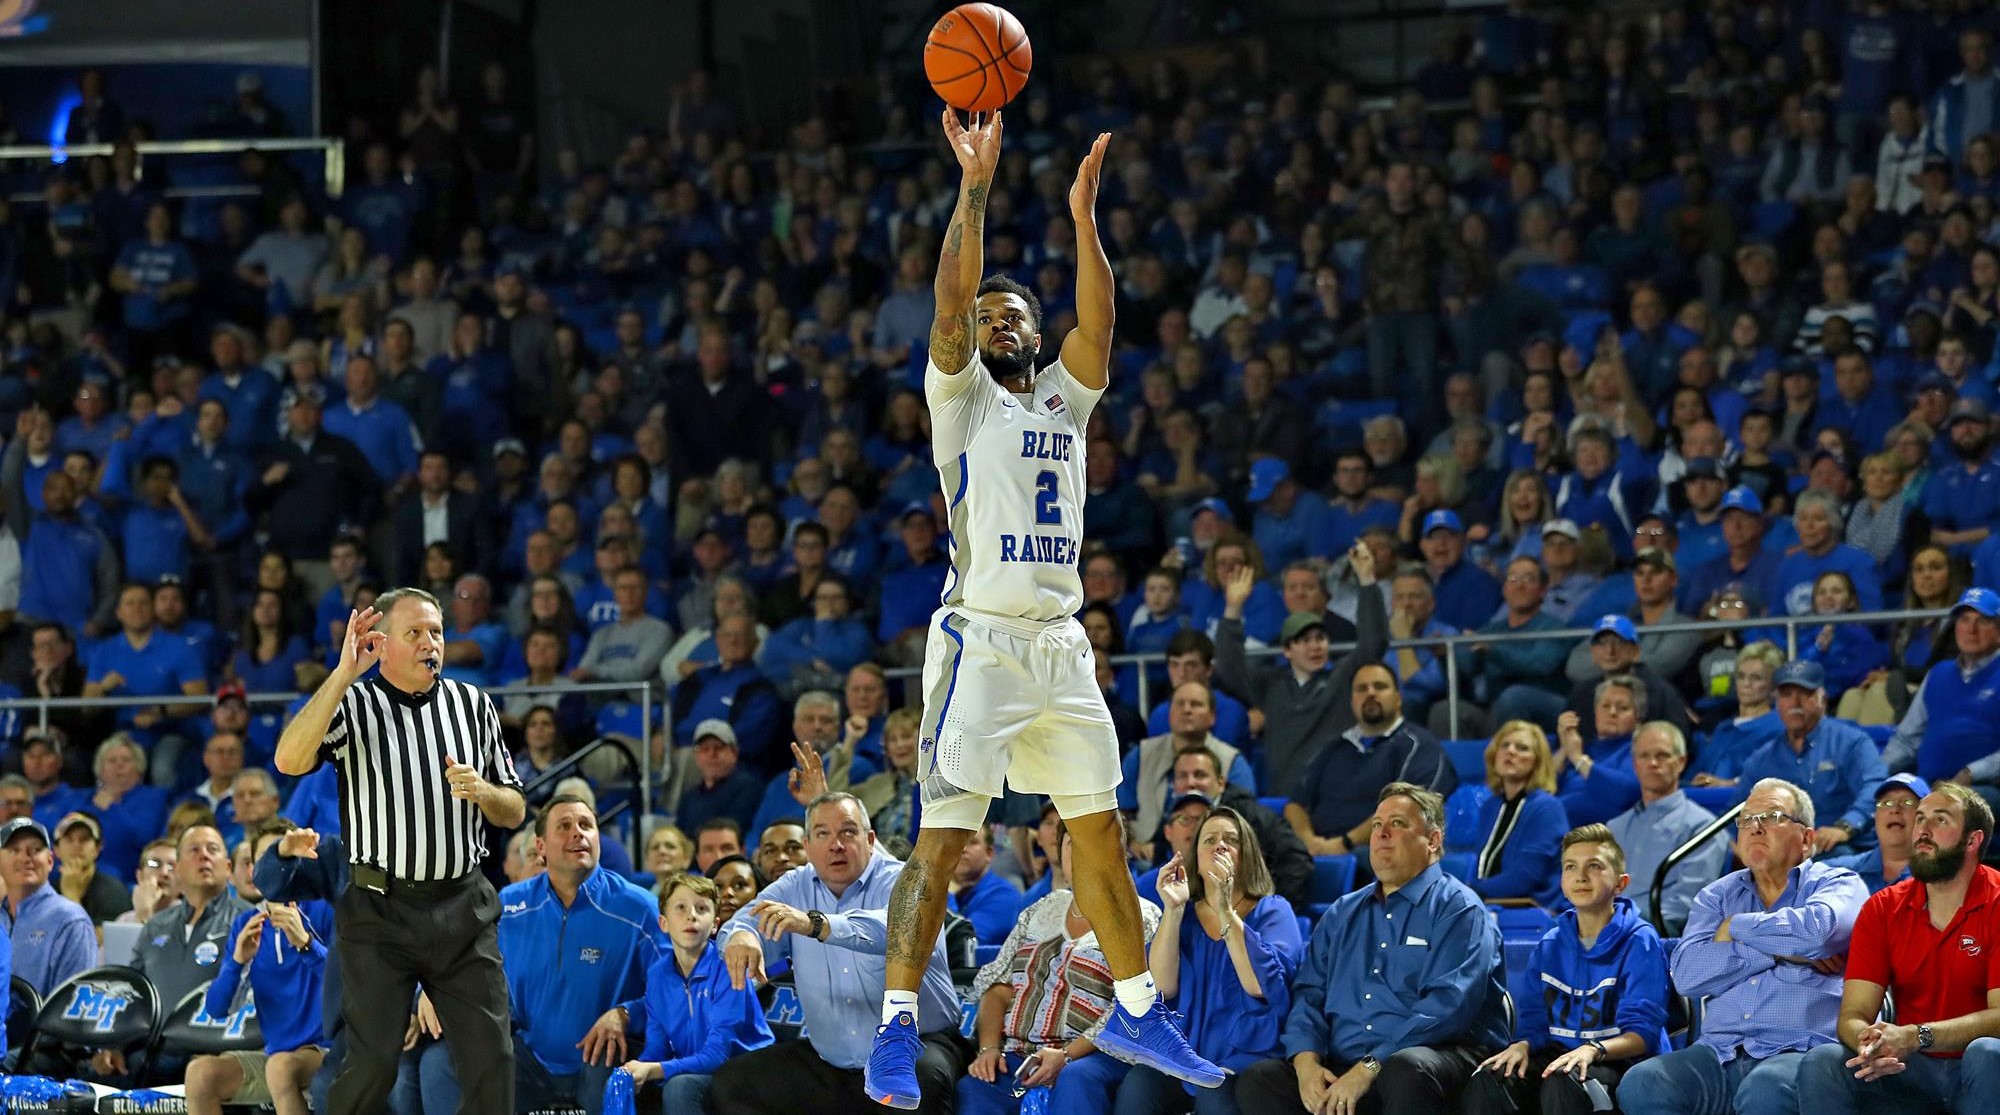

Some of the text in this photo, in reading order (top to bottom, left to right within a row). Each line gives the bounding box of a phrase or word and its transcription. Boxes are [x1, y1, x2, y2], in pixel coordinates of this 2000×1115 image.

[1021, 430, 1073, 462] BLUE
[1035, 469, 1063, 526] 2
[504, 901, 527, 913] PING
[62, 983, 128, 1033] MT
[765, 986, 809, 1038] M
[113, 1097, 141, 1114] BLUE
